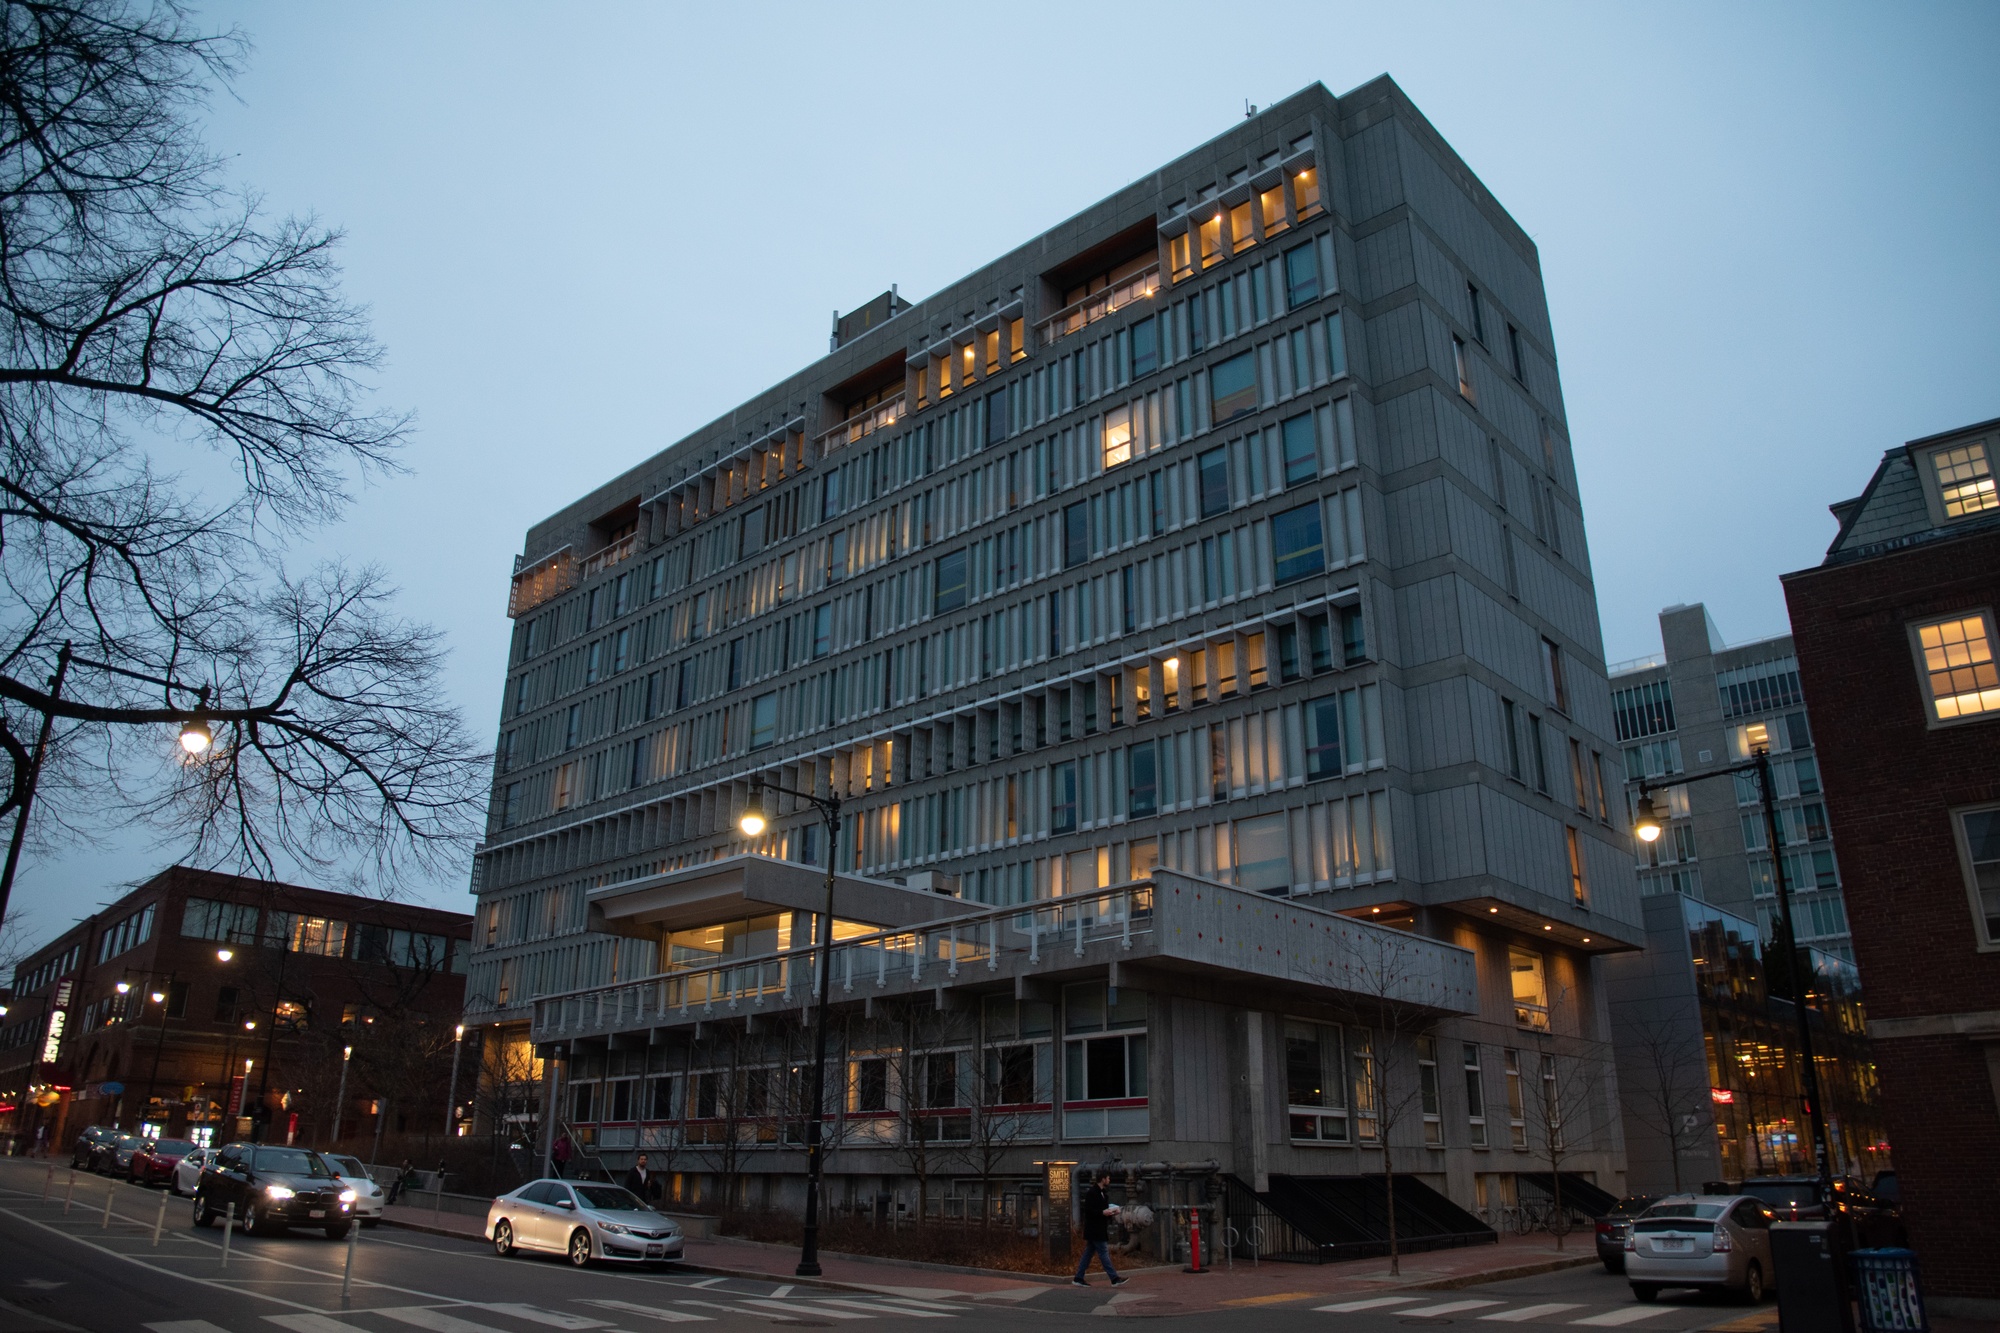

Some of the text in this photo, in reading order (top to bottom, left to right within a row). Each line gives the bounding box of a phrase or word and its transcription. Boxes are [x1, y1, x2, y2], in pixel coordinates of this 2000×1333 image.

[42, 980, 73, 1063] THE GARAGE
[1682, 1115, 1698, 1133] P
[1049, 1170, 1069, 1179] SMITH
